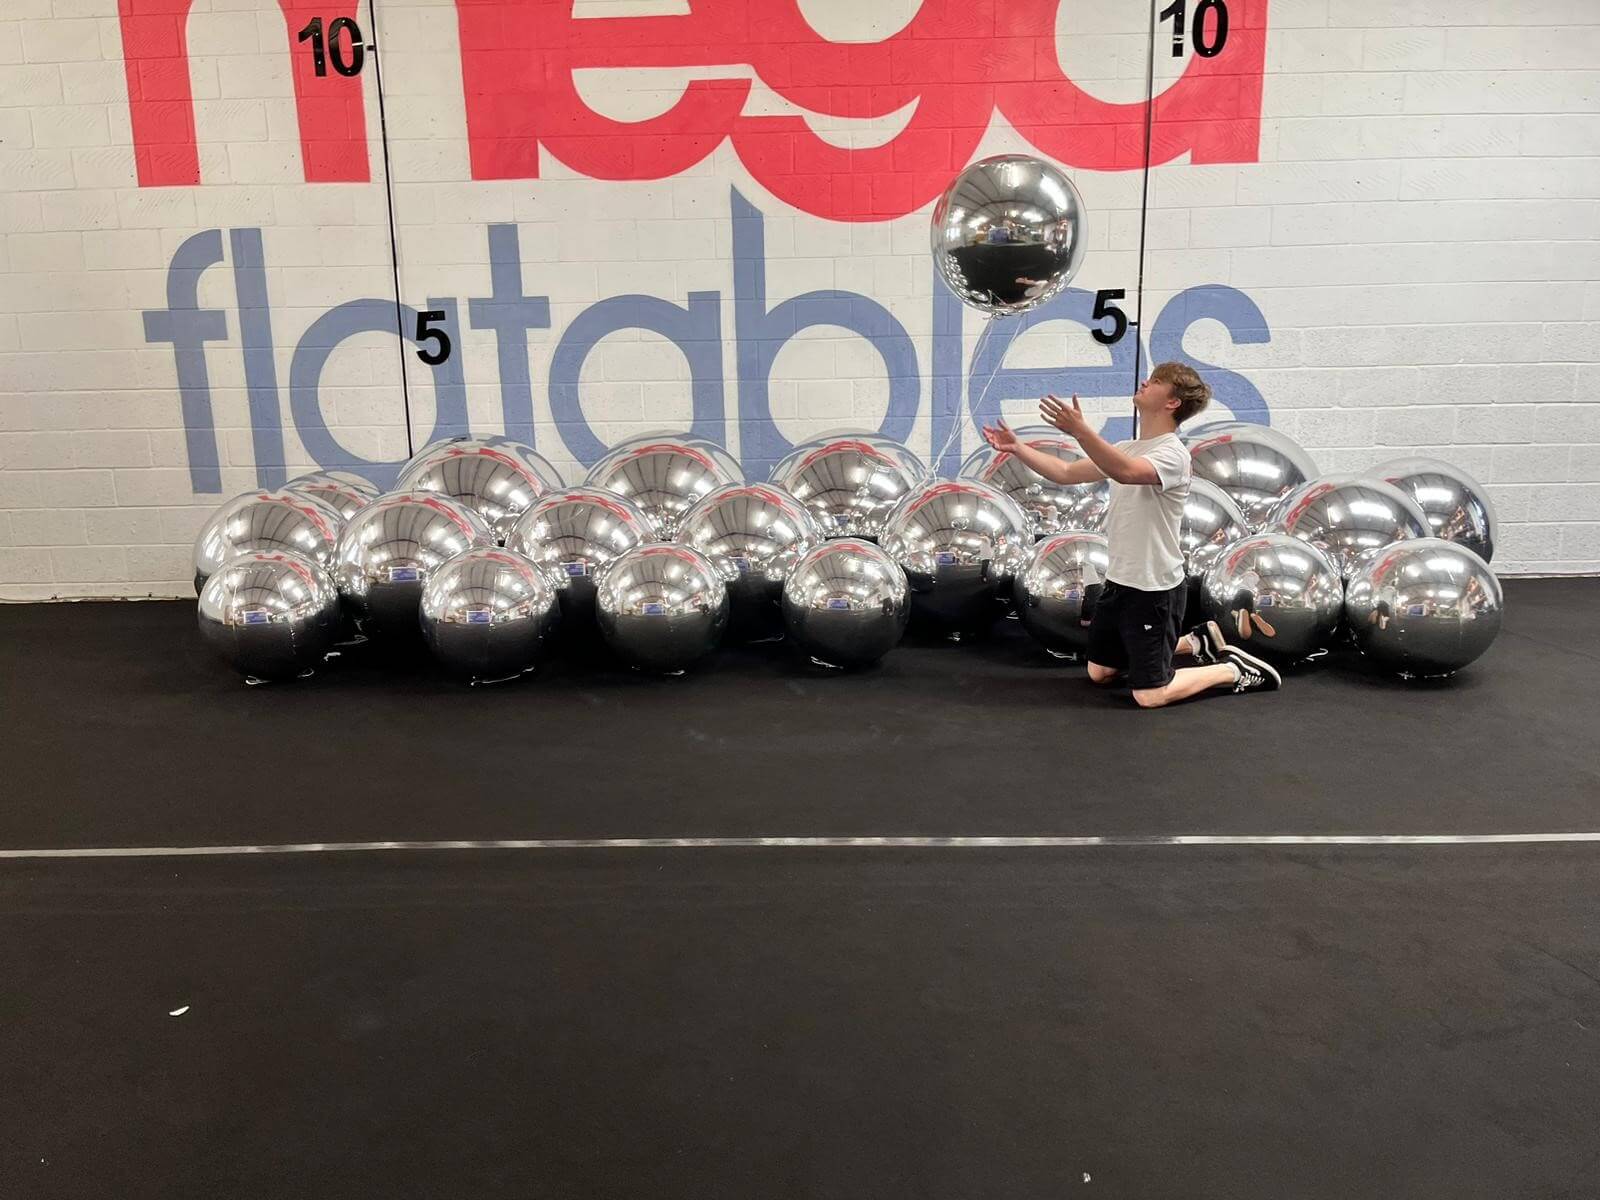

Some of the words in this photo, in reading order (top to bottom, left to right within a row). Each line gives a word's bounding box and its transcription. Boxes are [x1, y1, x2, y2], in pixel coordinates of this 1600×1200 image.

[298, 17, 364, 77] 10
[1159, 0, 1229, 58] 10
[415, 310, 451, 366] 5
[1090, 289, 1128, 345] 5
